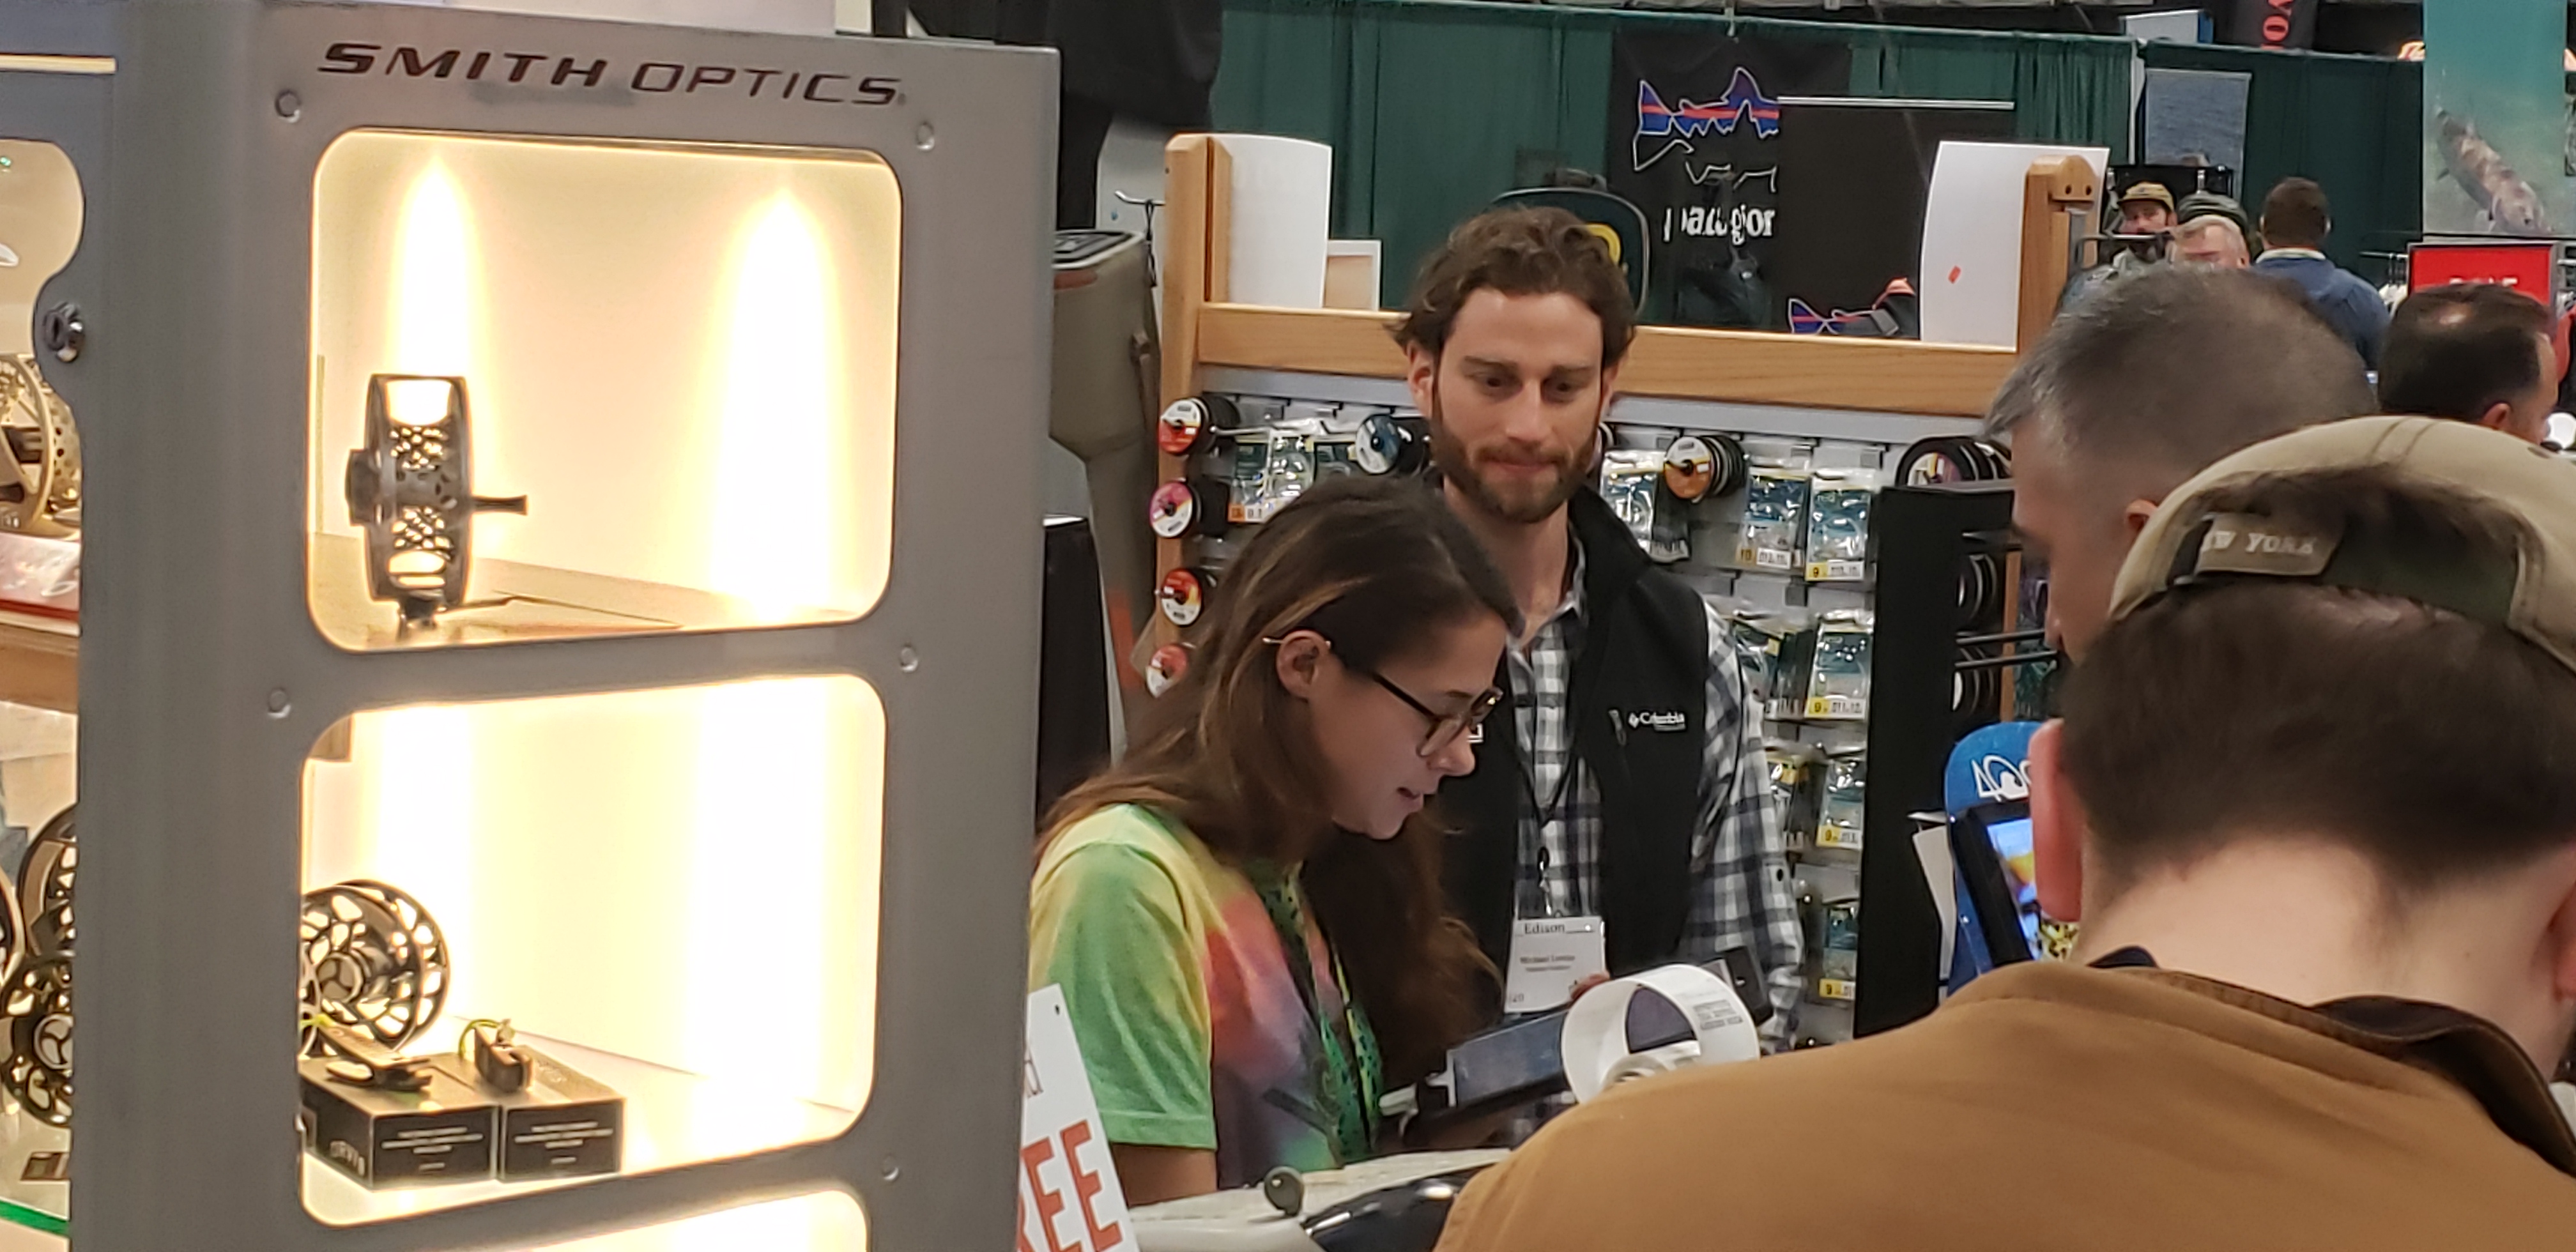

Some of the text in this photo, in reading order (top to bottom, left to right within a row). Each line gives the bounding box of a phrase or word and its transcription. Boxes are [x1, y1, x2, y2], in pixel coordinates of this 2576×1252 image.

[318, 42, 903, 105] SMITH OPTICS
[2244, 532, 2317, 555] YORK
[1524, 922, 1565, 935] Edison
